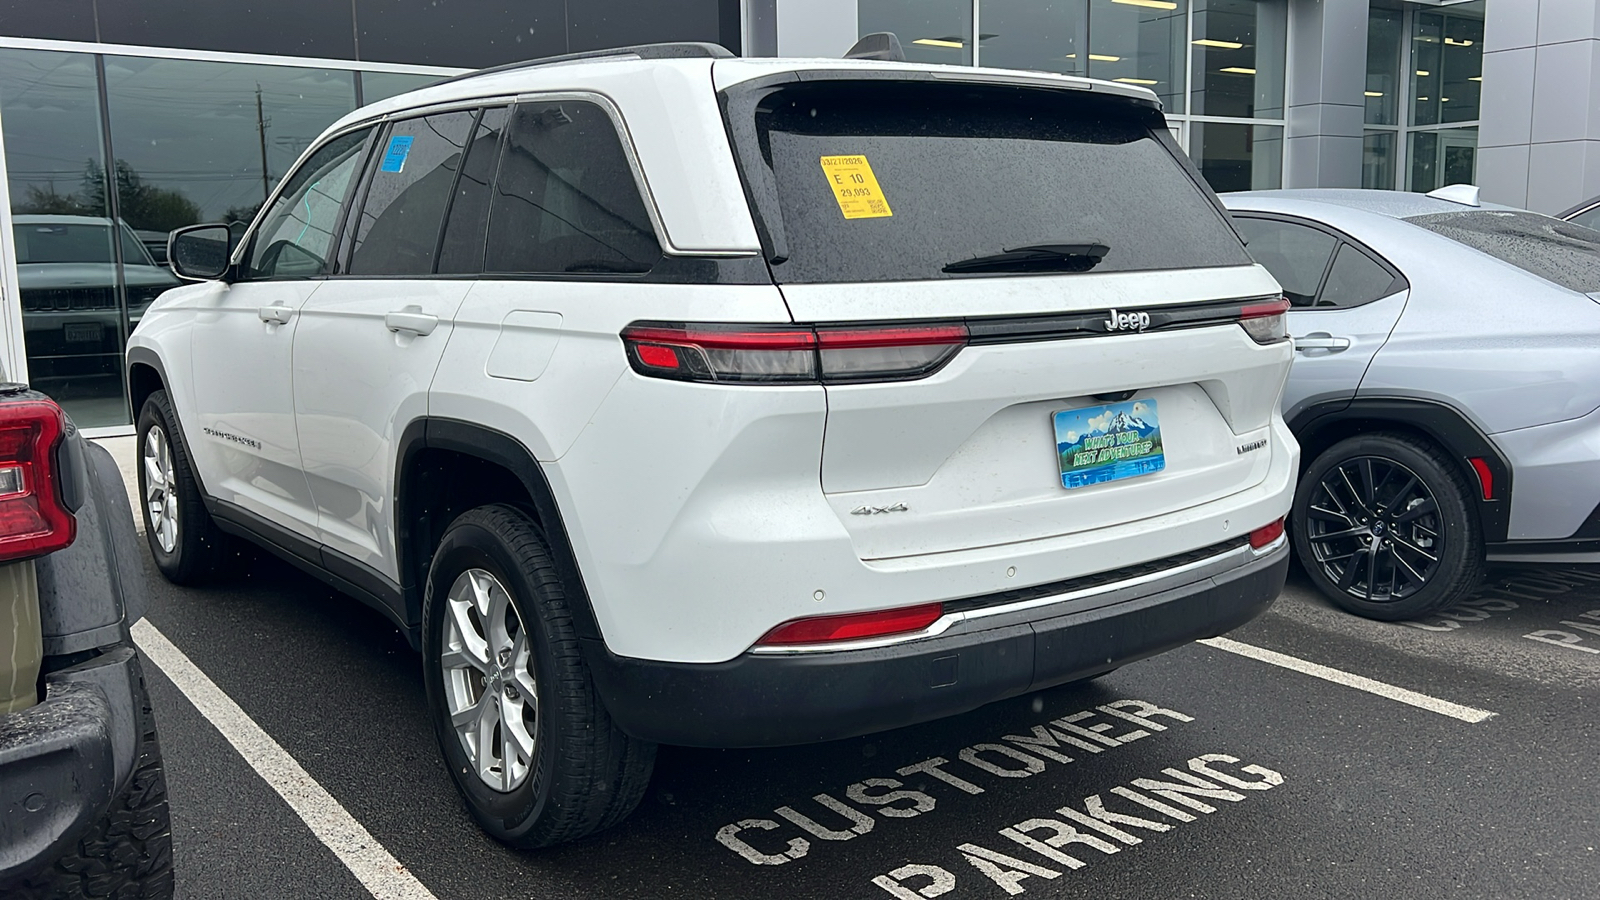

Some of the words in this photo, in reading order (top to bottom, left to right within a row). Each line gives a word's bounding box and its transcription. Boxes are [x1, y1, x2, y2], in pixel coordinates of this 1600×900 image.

[833, 174, 843, 185] E
[849, 173, 865, 184] 10
[840, 188, 871, 198] 29,093
[1104, 308, 1150, 333] Jeep
[1084, 433, 1116, 451] WHAT'S
[1115, 430, 1140, 446] YOUR
[1073, 450, 1098, 467] NEXT
[1097, 440, 1153, 463] ADVENTURE?
[715, 698, 1196, 866] CUSTOMER
[871, 753, 1285, 900] PARKING
